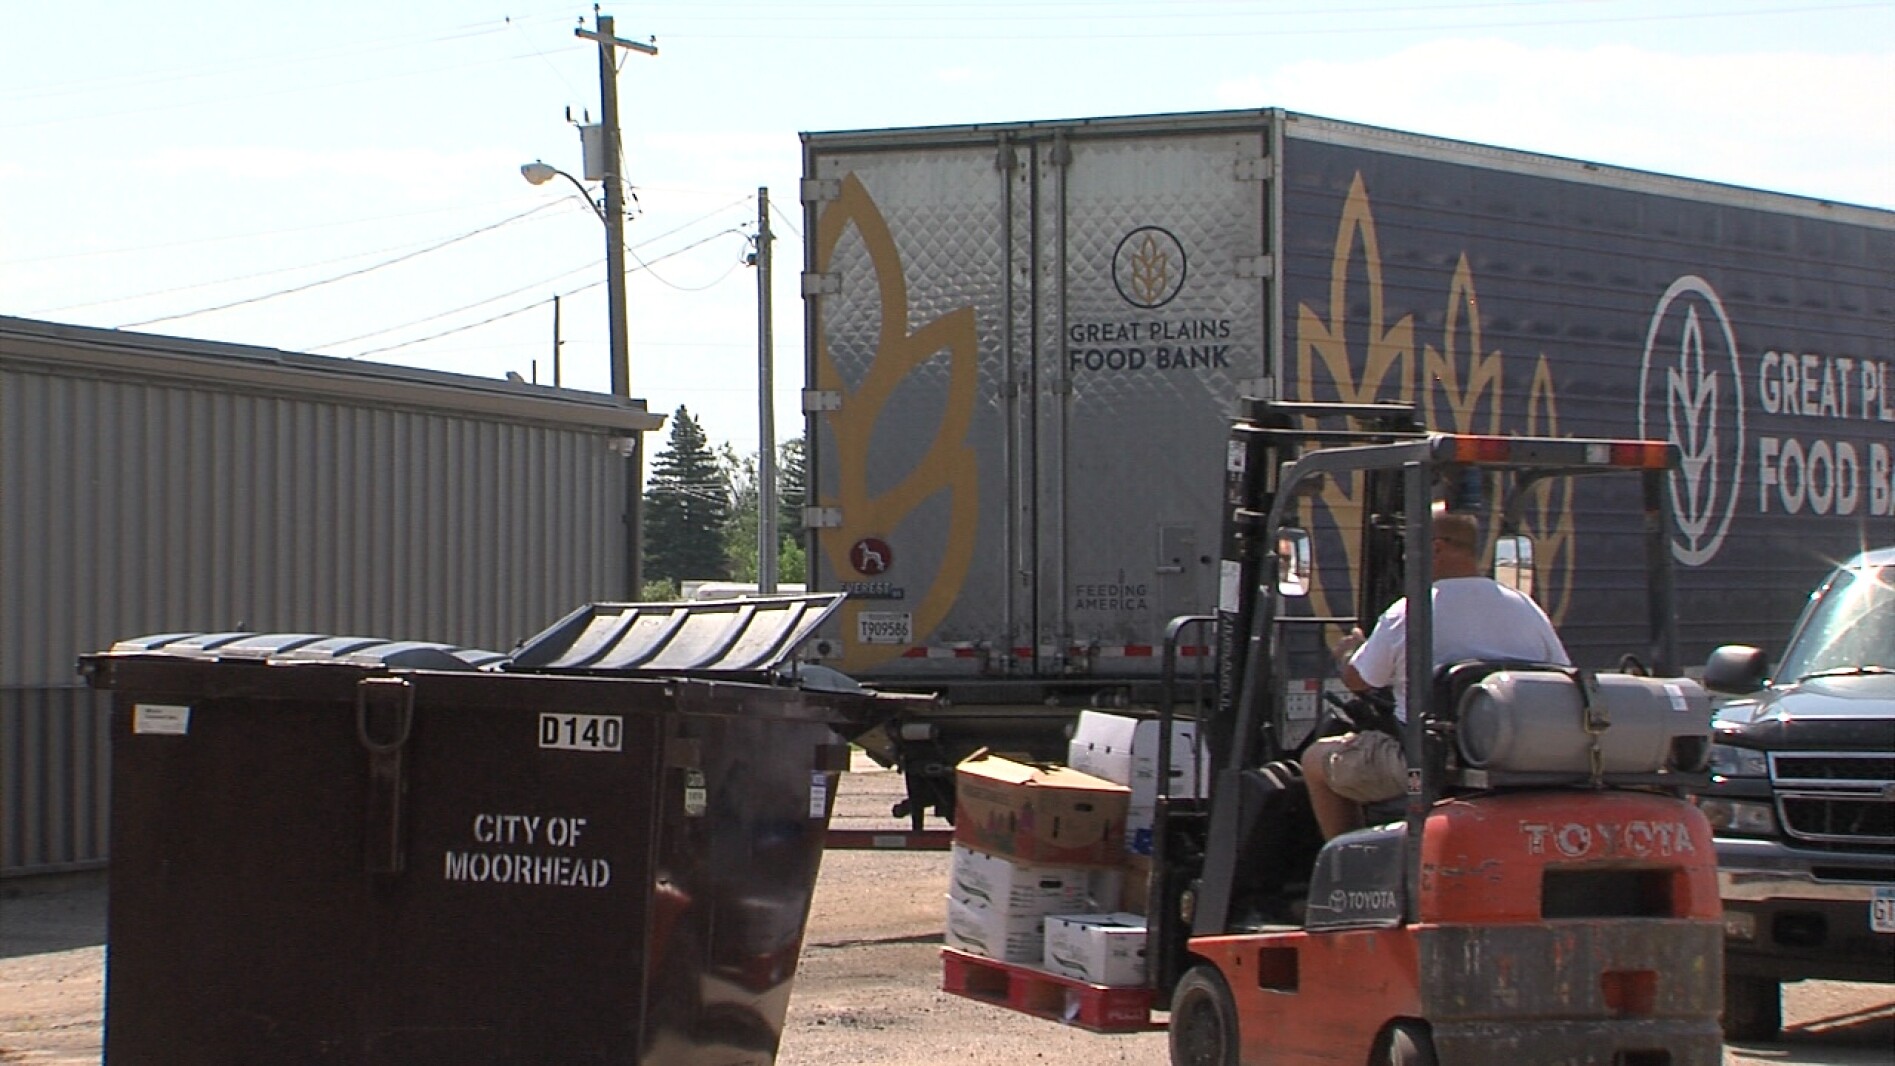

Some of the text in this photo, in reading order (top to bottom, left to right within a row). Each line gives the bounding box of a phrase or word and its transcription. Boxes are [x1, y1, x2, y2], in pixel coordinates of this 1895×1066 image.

[1070, 320, 1230, 343] GREAT PLAINS
[1070, 345, 1230, 371] FOOD BANK
[1759, 351, 1853, 418] GREAT
[1759, 437, 1895, 517] FOOD B
[1075, 599, 1148, 611] AMERICA
[1076, 584, 1147, 597] FEEDING
[541, 716, 620, 748] D140
[474, 813, 587, 847] CITY OF
[1519, 820, 1696, 857] TOYOTA
[445, 851, 611, 887] MOORHEAD
[1348, 890, 1397, 909] TOYOTA
